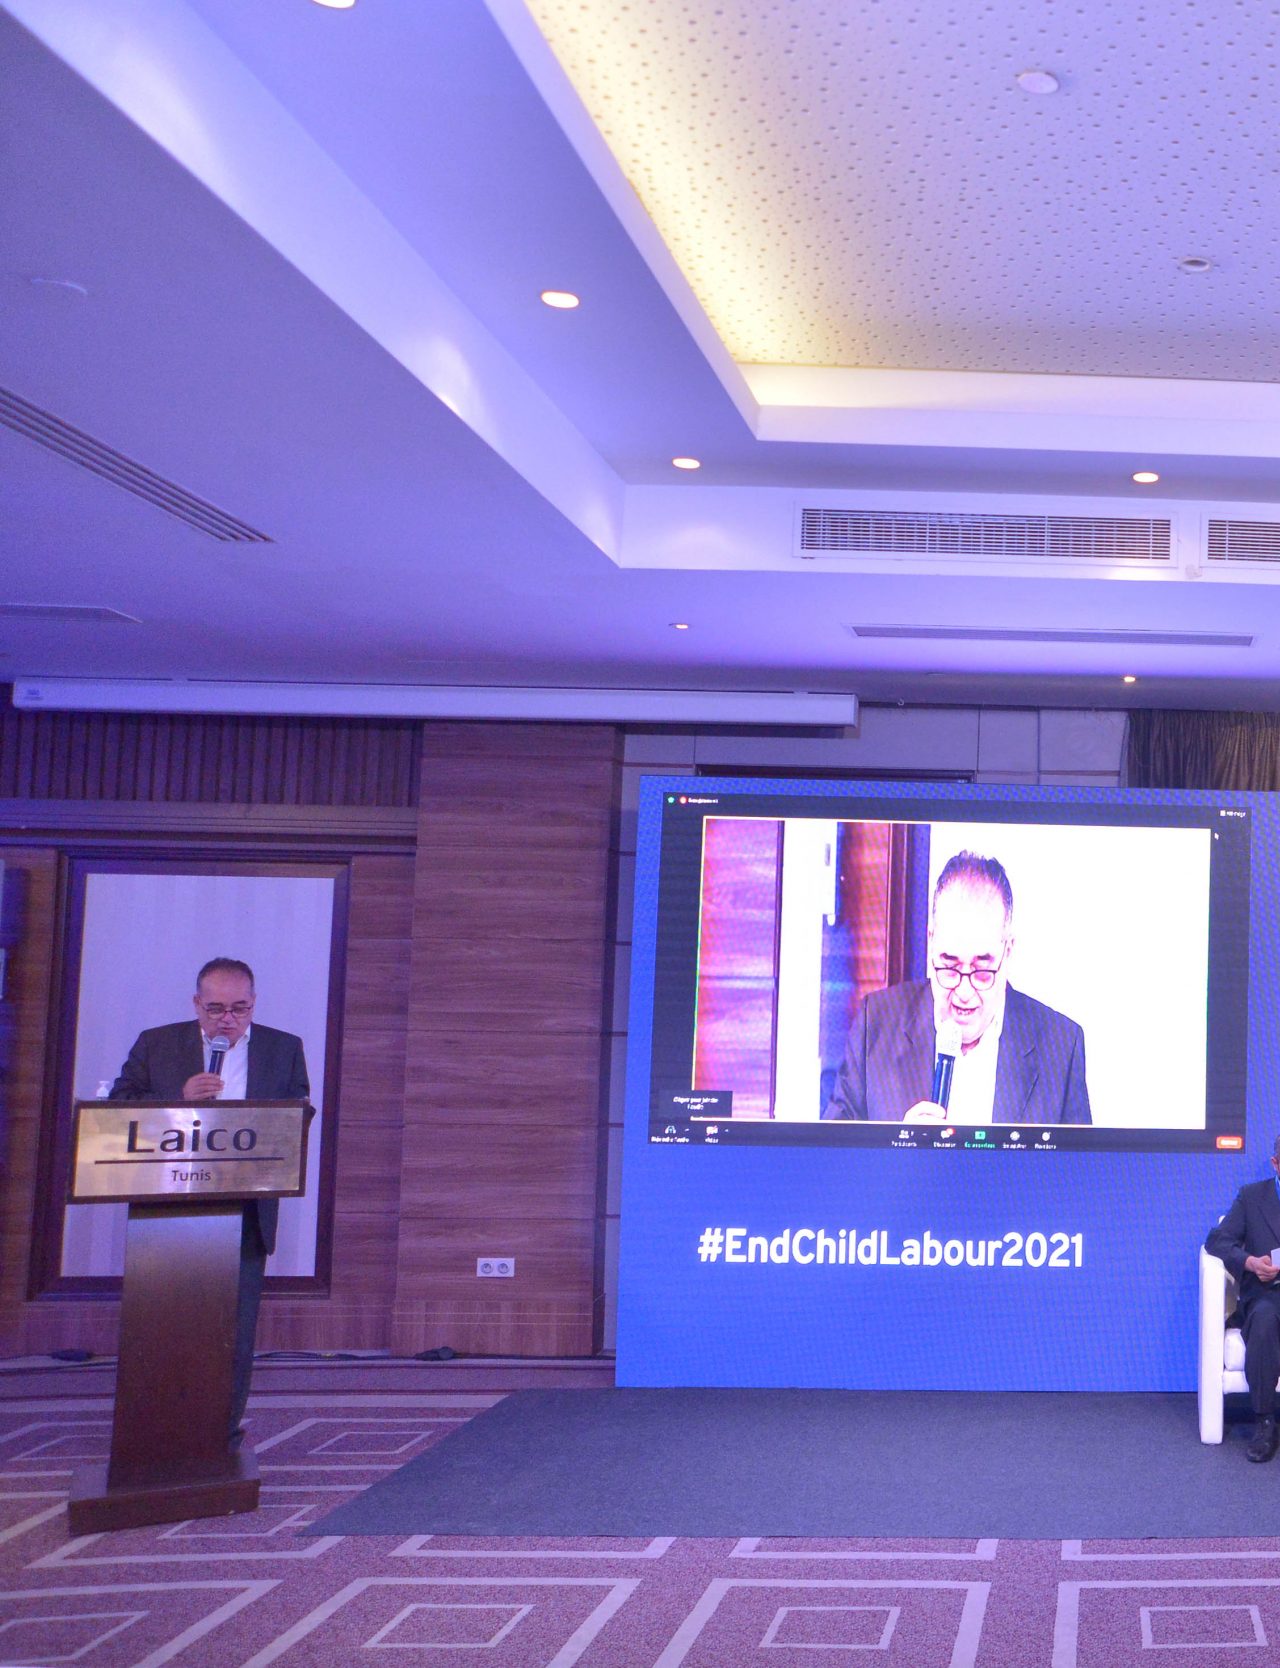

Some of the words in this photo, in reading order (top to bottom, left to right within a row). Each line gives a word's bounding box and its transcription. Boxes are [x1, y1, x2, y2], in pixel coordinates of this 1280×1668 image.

[127, 1119, 257, 1153] Laico
[171, 1169, 211, 1182] Tunis
[698, 1227, 1083, 1267] #EndChildLabour2021
